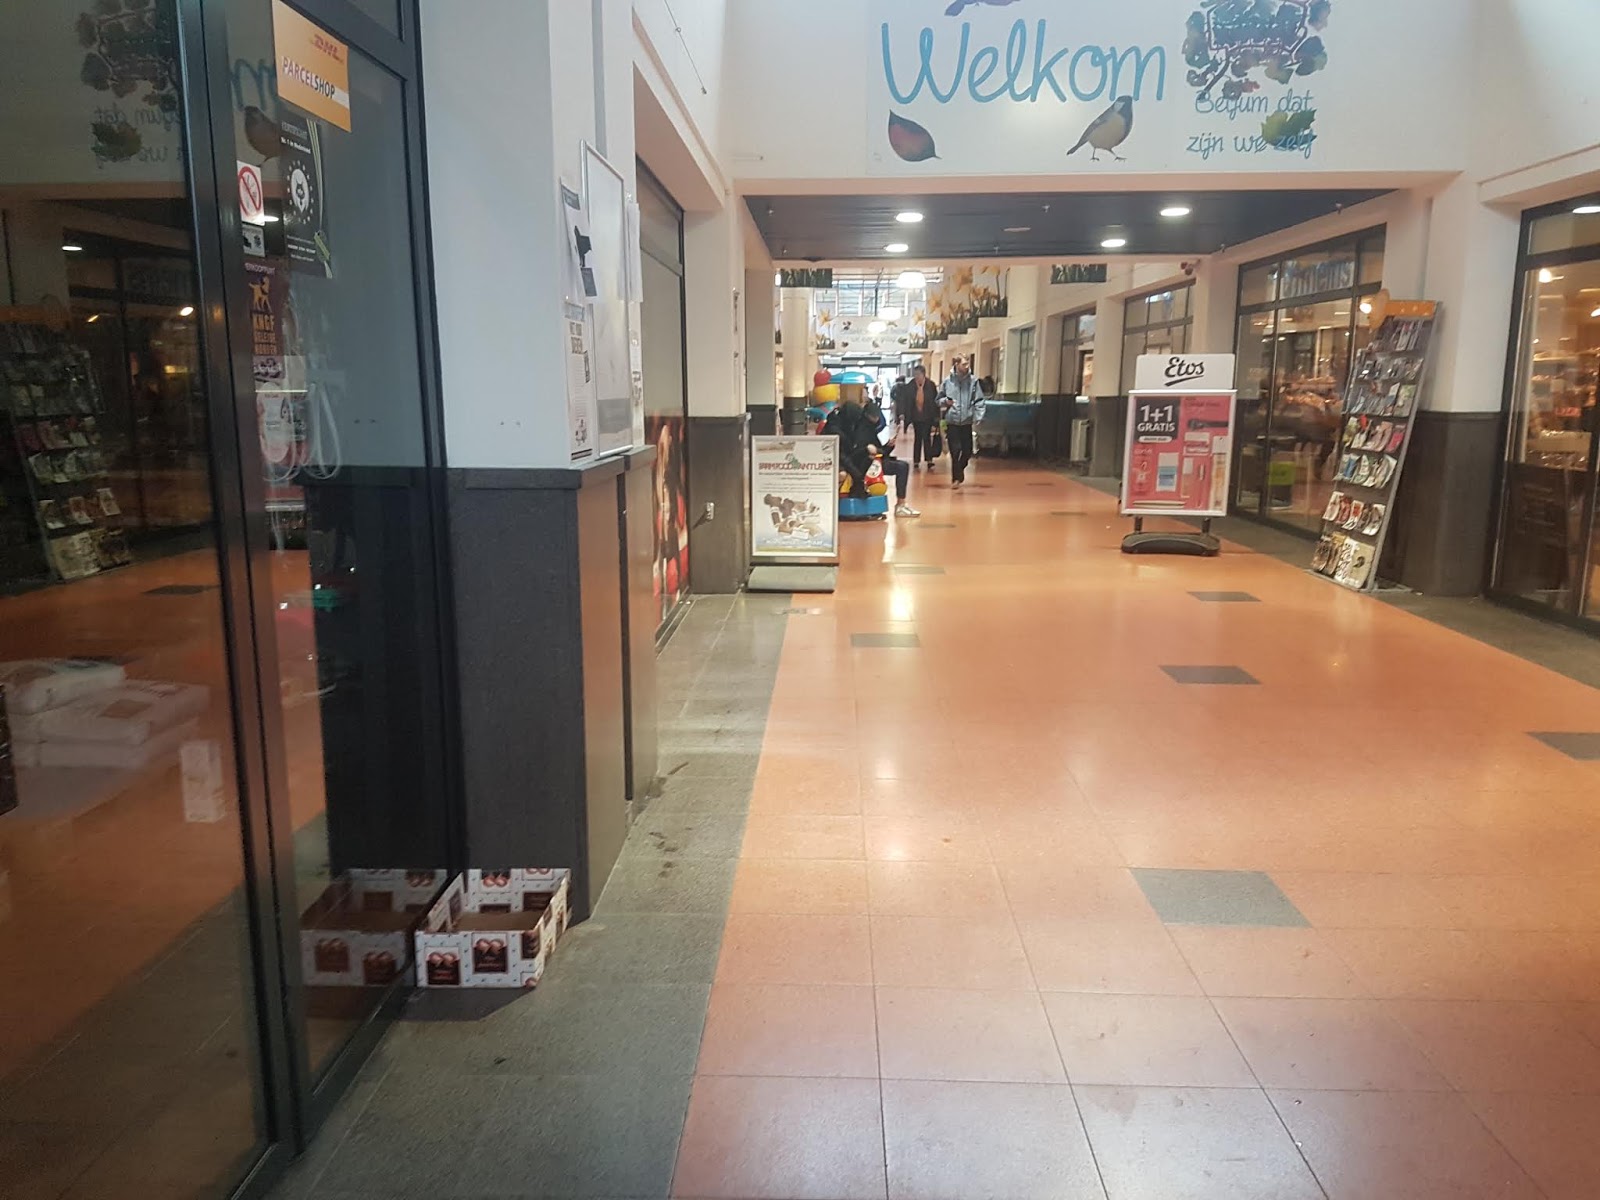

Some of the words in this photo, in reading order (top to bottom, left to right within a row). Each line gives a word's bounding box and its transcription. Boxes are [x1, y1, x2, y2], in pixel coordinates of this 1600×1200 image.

[312, 34, 342, 61] DHL
[881, 18, 1166, 105] Welkom
[282, 56, 336, 99] PARCELSHOP
[1278, 88, 1314, 112] dat
[1186, 132, 1224, 160] zijn
[1234, 135, 1268, 153] we
[1273, 128, 1314, 159] zelf
[252, 312, 275, 332] KNGF
[1164, 356, 1205, 379] Etos
[1140, 405, 1173, 422] 1+1
[1137, 422, 1176, 432] GRATIS
